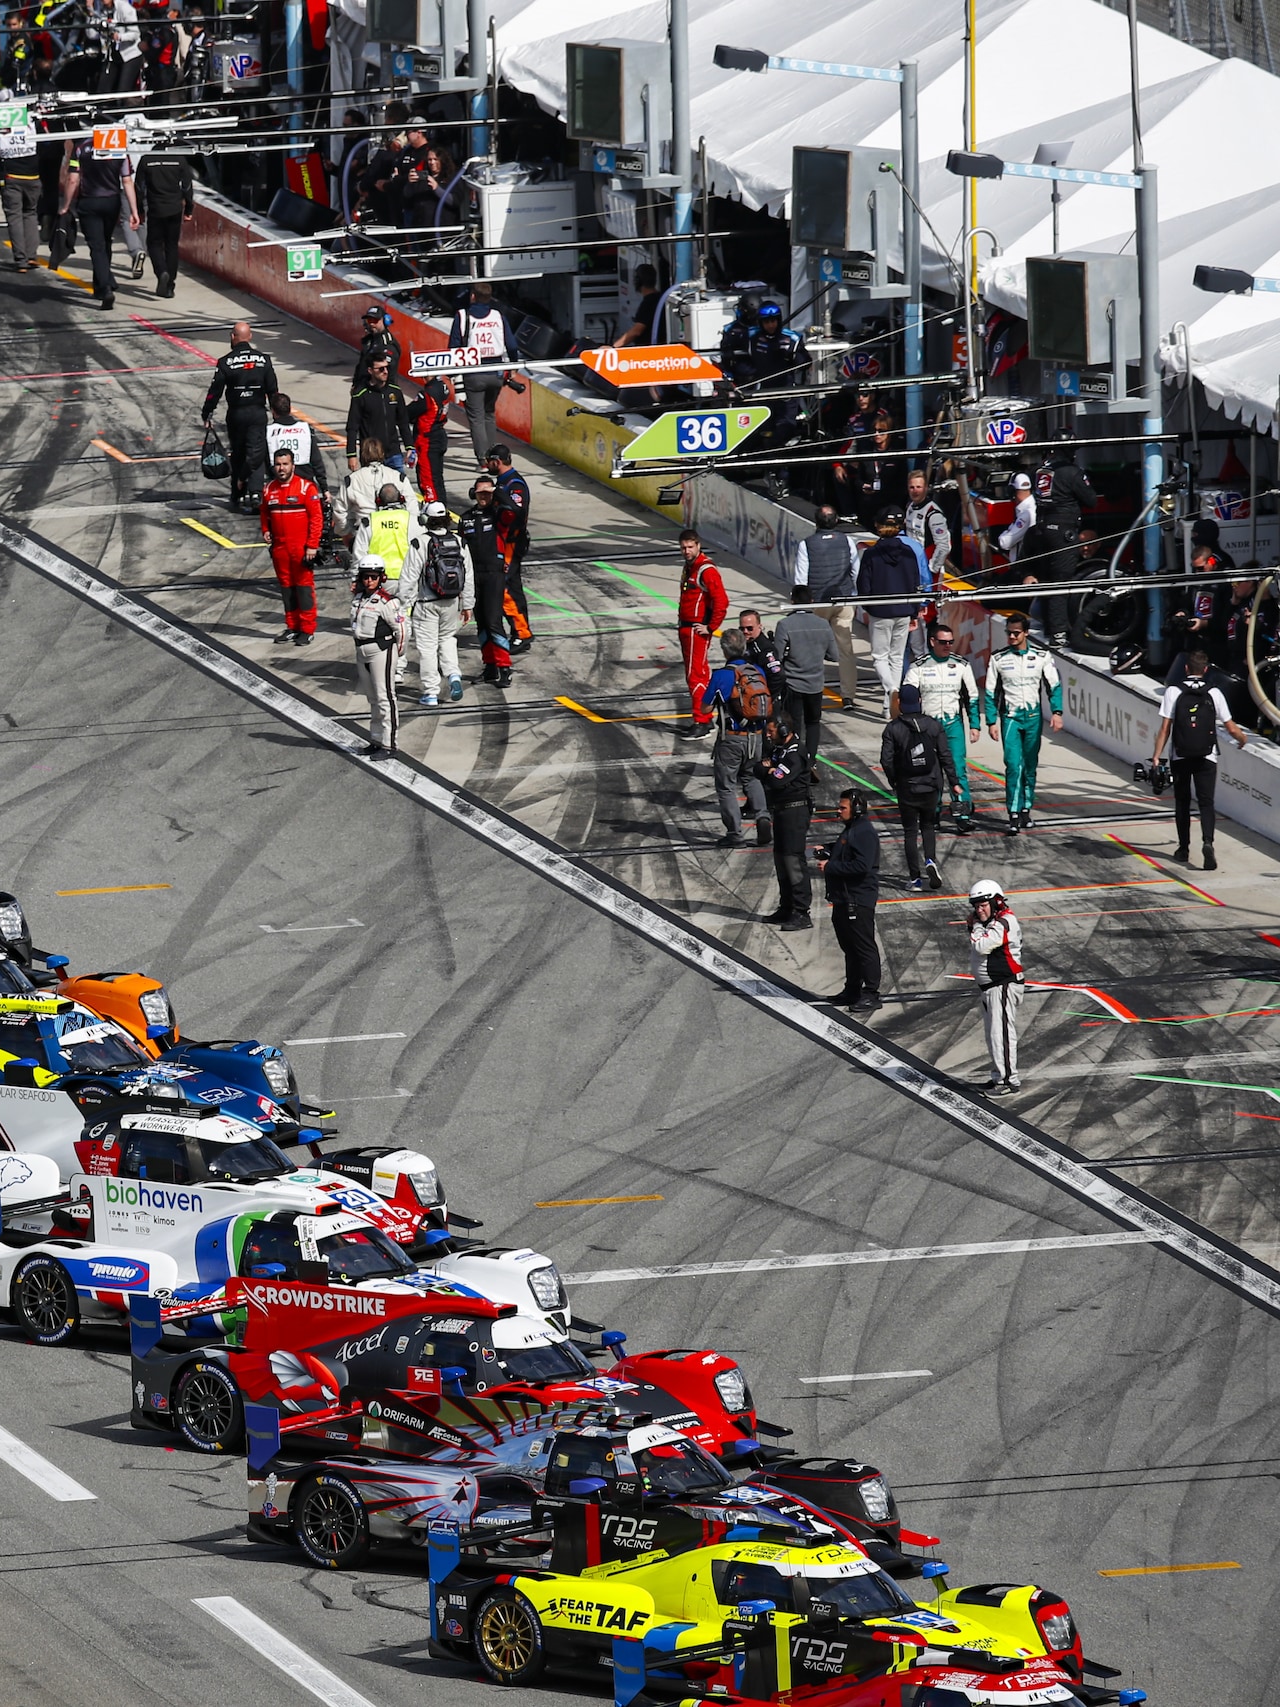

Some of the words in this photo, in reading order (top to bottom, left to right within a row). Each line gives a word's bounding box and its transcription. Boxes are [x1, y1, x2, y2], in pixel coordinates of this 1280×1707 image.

[0, 108, 24, 126] 92
[100, 130, 120, 148] 74
[292, 252, 321, 270] 91
[508, 253, 559, 261] RILEY
[475, 333, 493, 345] 142
[454, 347, 479, 367] 33
[592, 350, 618, 371] 70
[629, 356, 690, 371] inception
[681, 416, 722, 451] 36
[279, 439, 299, 450] 289
[381, 521, 399, 530] NBC
[1224, 540, 1271, 549] ANDRTTI
[1068, 679, 1132, 745] GALLANT
[19, 1089, 57, 1102] SEAFOOD
[140, 1122, 187, 1133] WORKWEAR
[145, 1116, 187, 1125] MASCOT
[344, 1165, 370, 1174] LOGISTICS
[106, 1178, 203, 1213] biohaven
[336, 1190, 370, 1207] 20
[153, 1215, 175, 1226] kimoa
[22, 1257, 50, 1274] MICHELIN
[93, 1261, 140, 1278] pronto
[252, 1285, 387, 1317] CROWDSTRIKE
[335, 1326, 390, 1364] Accel
[206, 1365, 235, 1394] MICHELIN
[383, 1408, 425, 1431] ORIFARM
[328, 1478, 359, 1506] MICHELIN
[601, 1513, 658, 1541] TDS
[613, 1537, 653, 1550] RACING
[449, 1594, 467, 1605] HBI
[560, 1598, 594, 1612] FEAR
[811, 1602, 832, 1613] TDS
[524, 1602, 542, 1648] MICHELIN
[568, 1612, 591, 1625] THE
[595, 1603, 650, 1631] TAF
[791, 1636, 848, 1664] TDS
[803, 1660, 843, 1674] RACING
